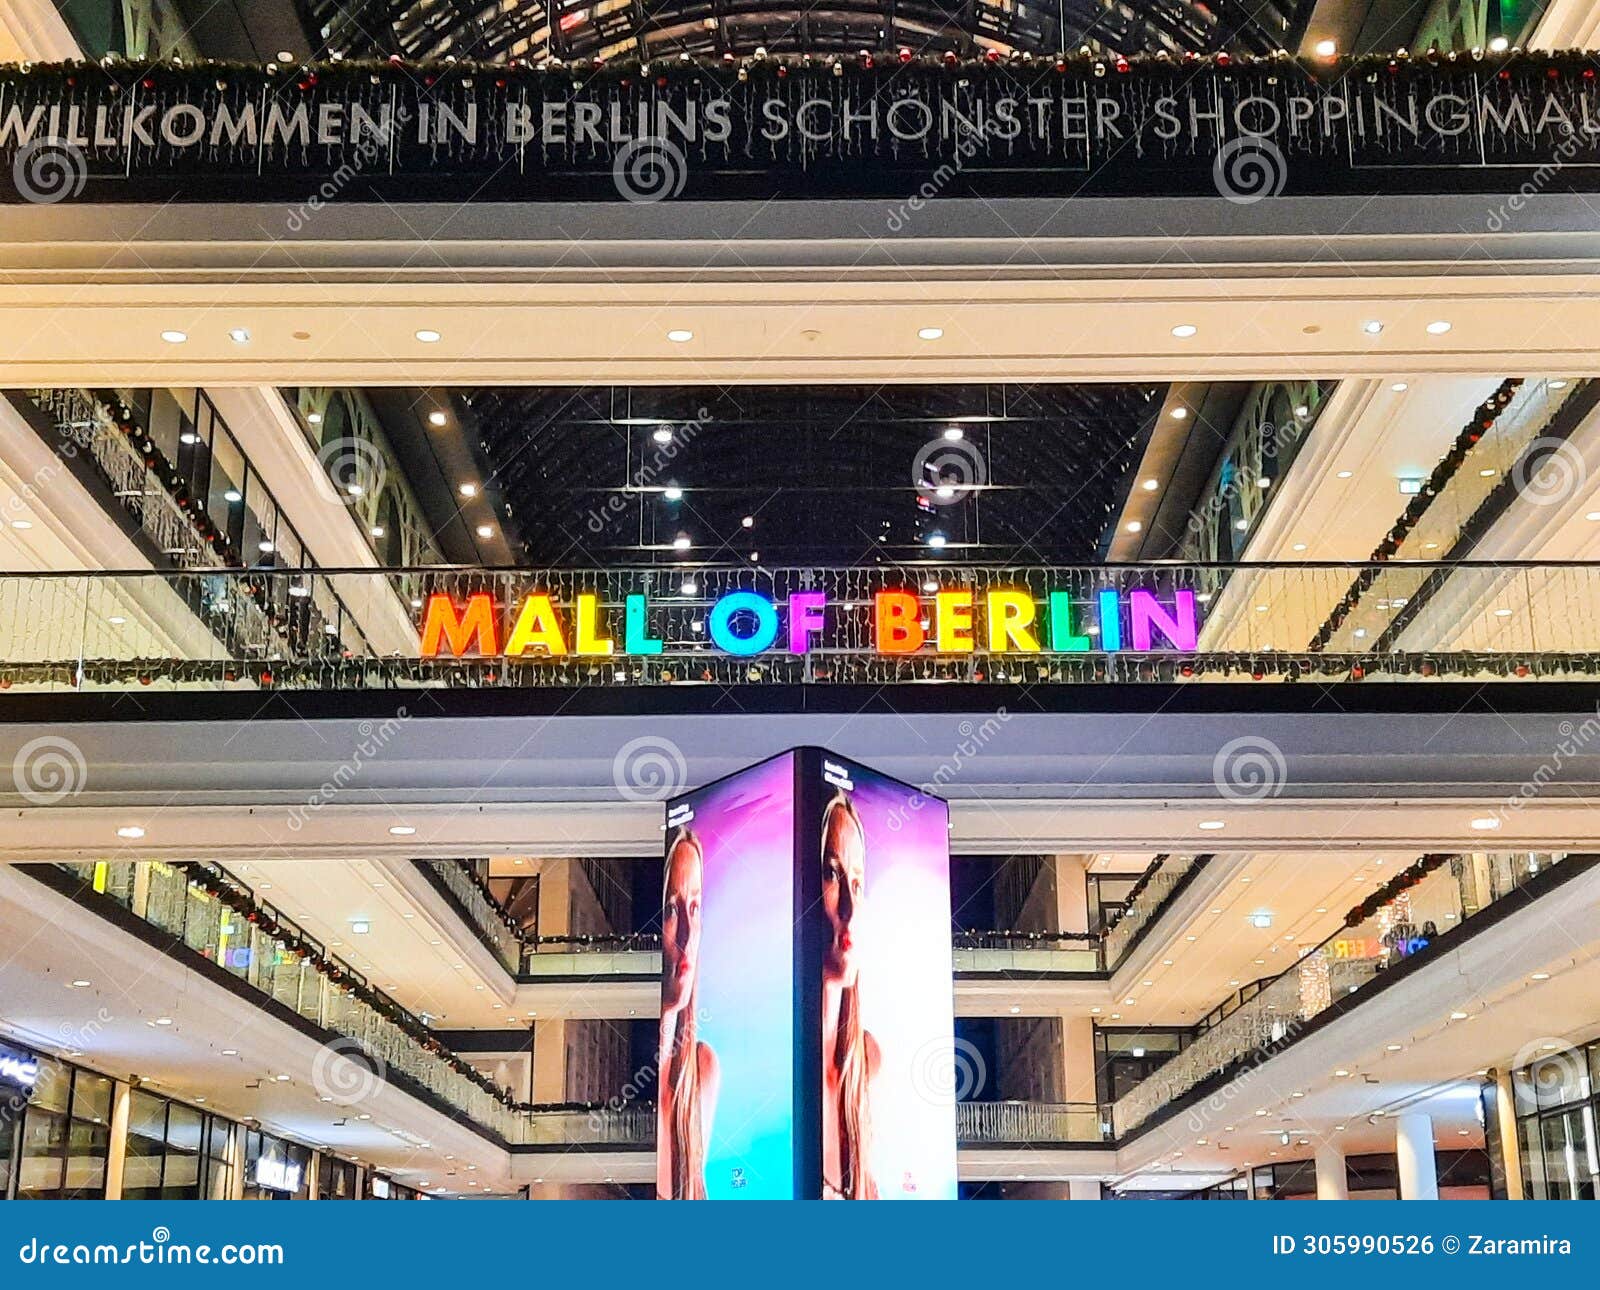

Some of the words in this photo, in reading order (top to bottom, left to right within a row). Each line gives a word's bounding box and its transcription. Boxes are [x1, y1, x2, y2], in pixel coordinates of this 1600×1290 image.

[0, 102, 390, 147] WILLKOMMEN
[418, 101, 476, 144] IN
[505, 98, 732, 144] BERLINS
[761, 88, 1123, 142] SCHÖNSTER
[421, 592, 661, 657] MALL
[708, 590, 826, 655] OF
[875, 590, 1196, 654] BERLIN
